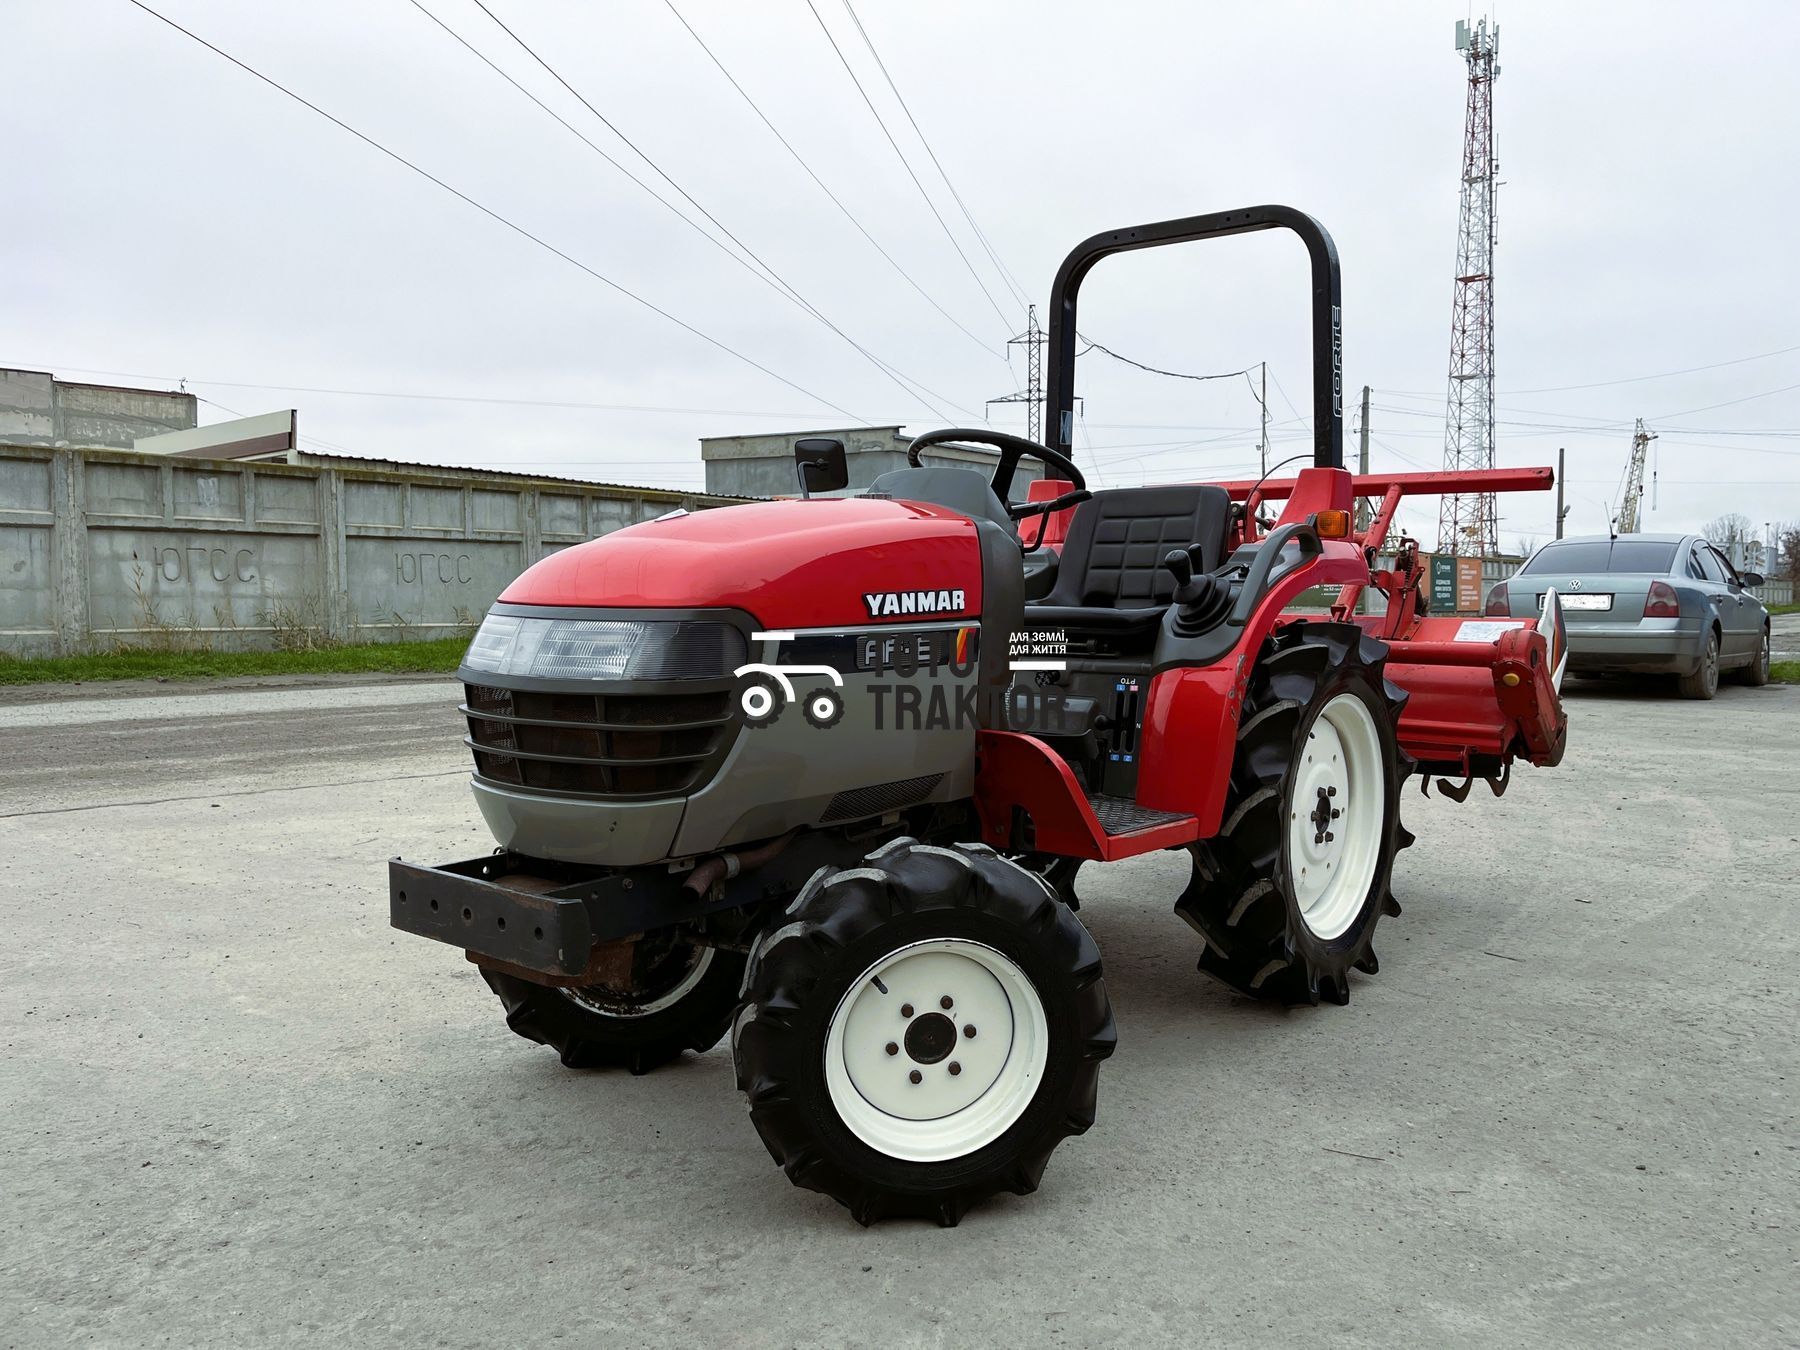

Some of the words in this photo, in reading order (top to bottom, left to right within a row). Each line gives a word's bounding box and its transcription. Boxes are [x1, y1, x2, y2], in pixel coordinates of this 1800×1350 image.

[1332, 305, 1342, 418] FORTE
[395, 553, 472, 585] ЮГСС
[865, 590, 965, 616] YANMAR
[1120, 677, 1136, 685] PTO
